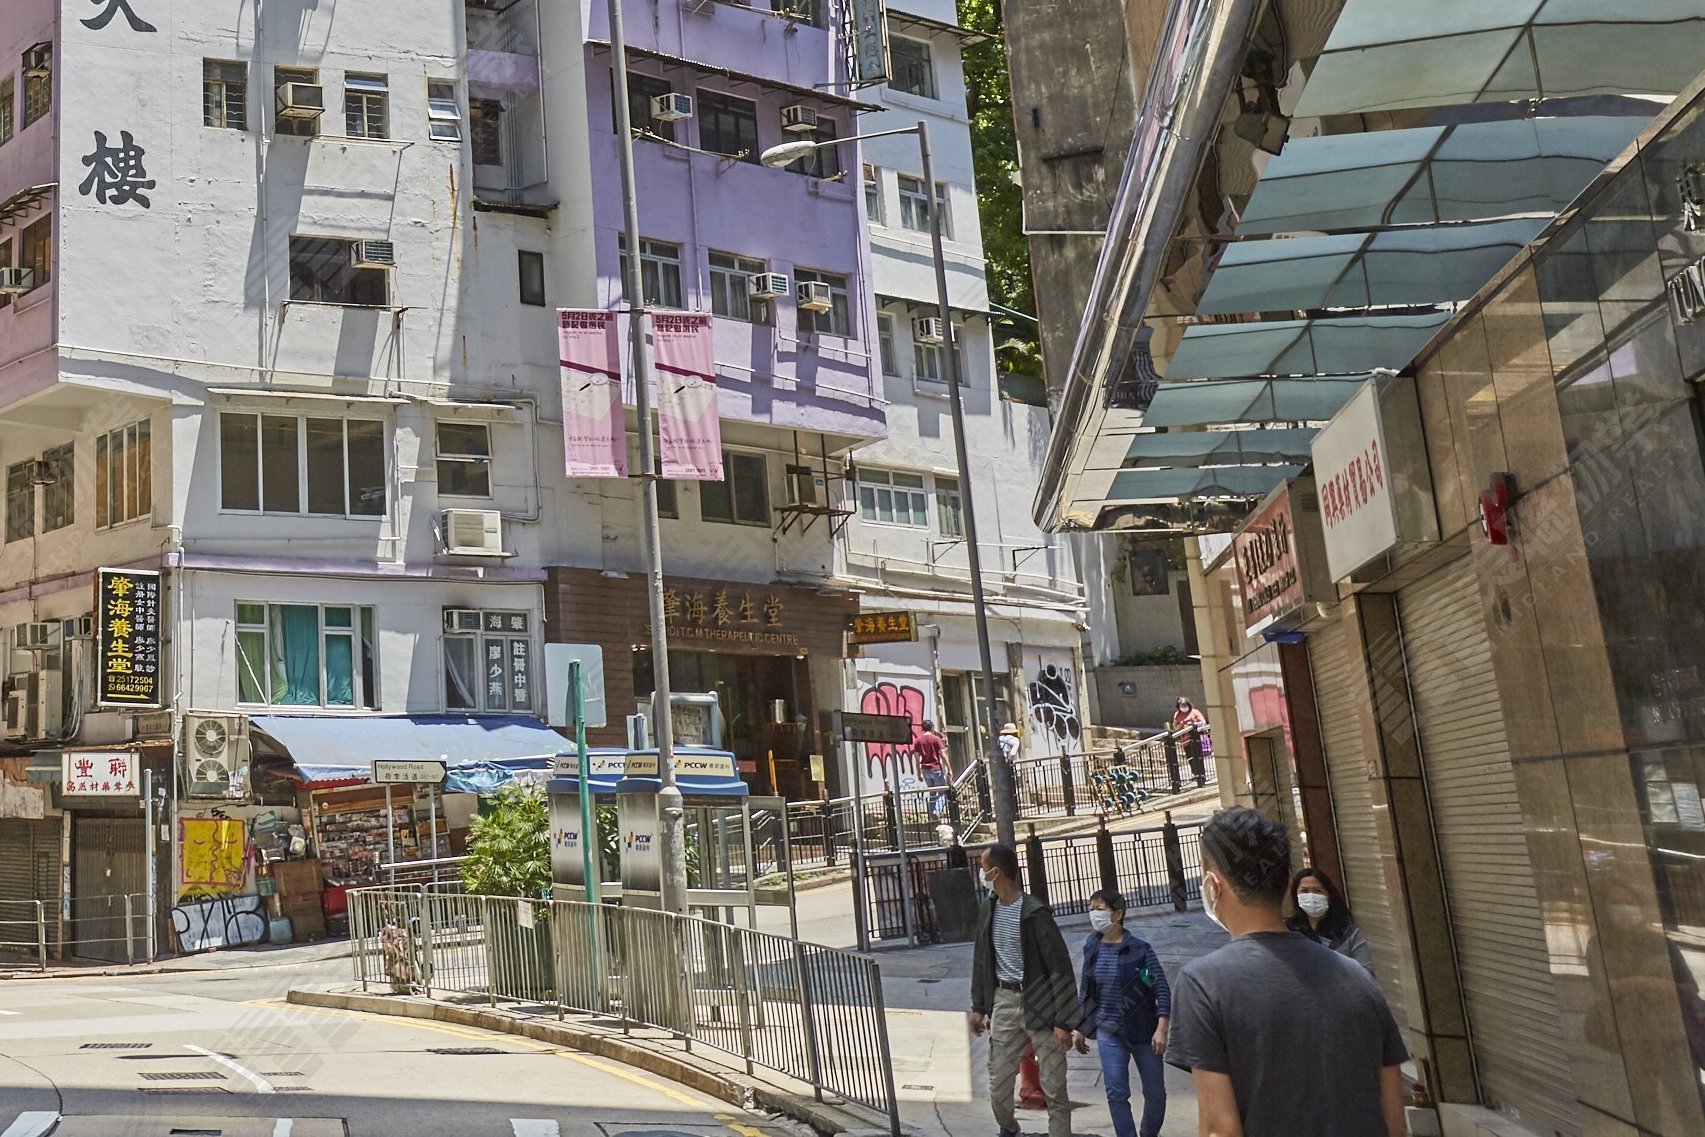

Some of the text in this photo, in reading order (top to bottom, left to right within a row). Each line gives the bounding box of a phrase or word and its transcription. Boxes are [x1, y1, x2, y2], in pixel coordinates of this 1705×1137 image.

[662, 587, 783, 627] 肇海養生堂
[106, 576, 133, 674] 肇海養生堂
[765, 632, 798, 646] CENTRE
[564, 832, 578, 840] PCCW
[635, 835, 651, 843] PCCW
